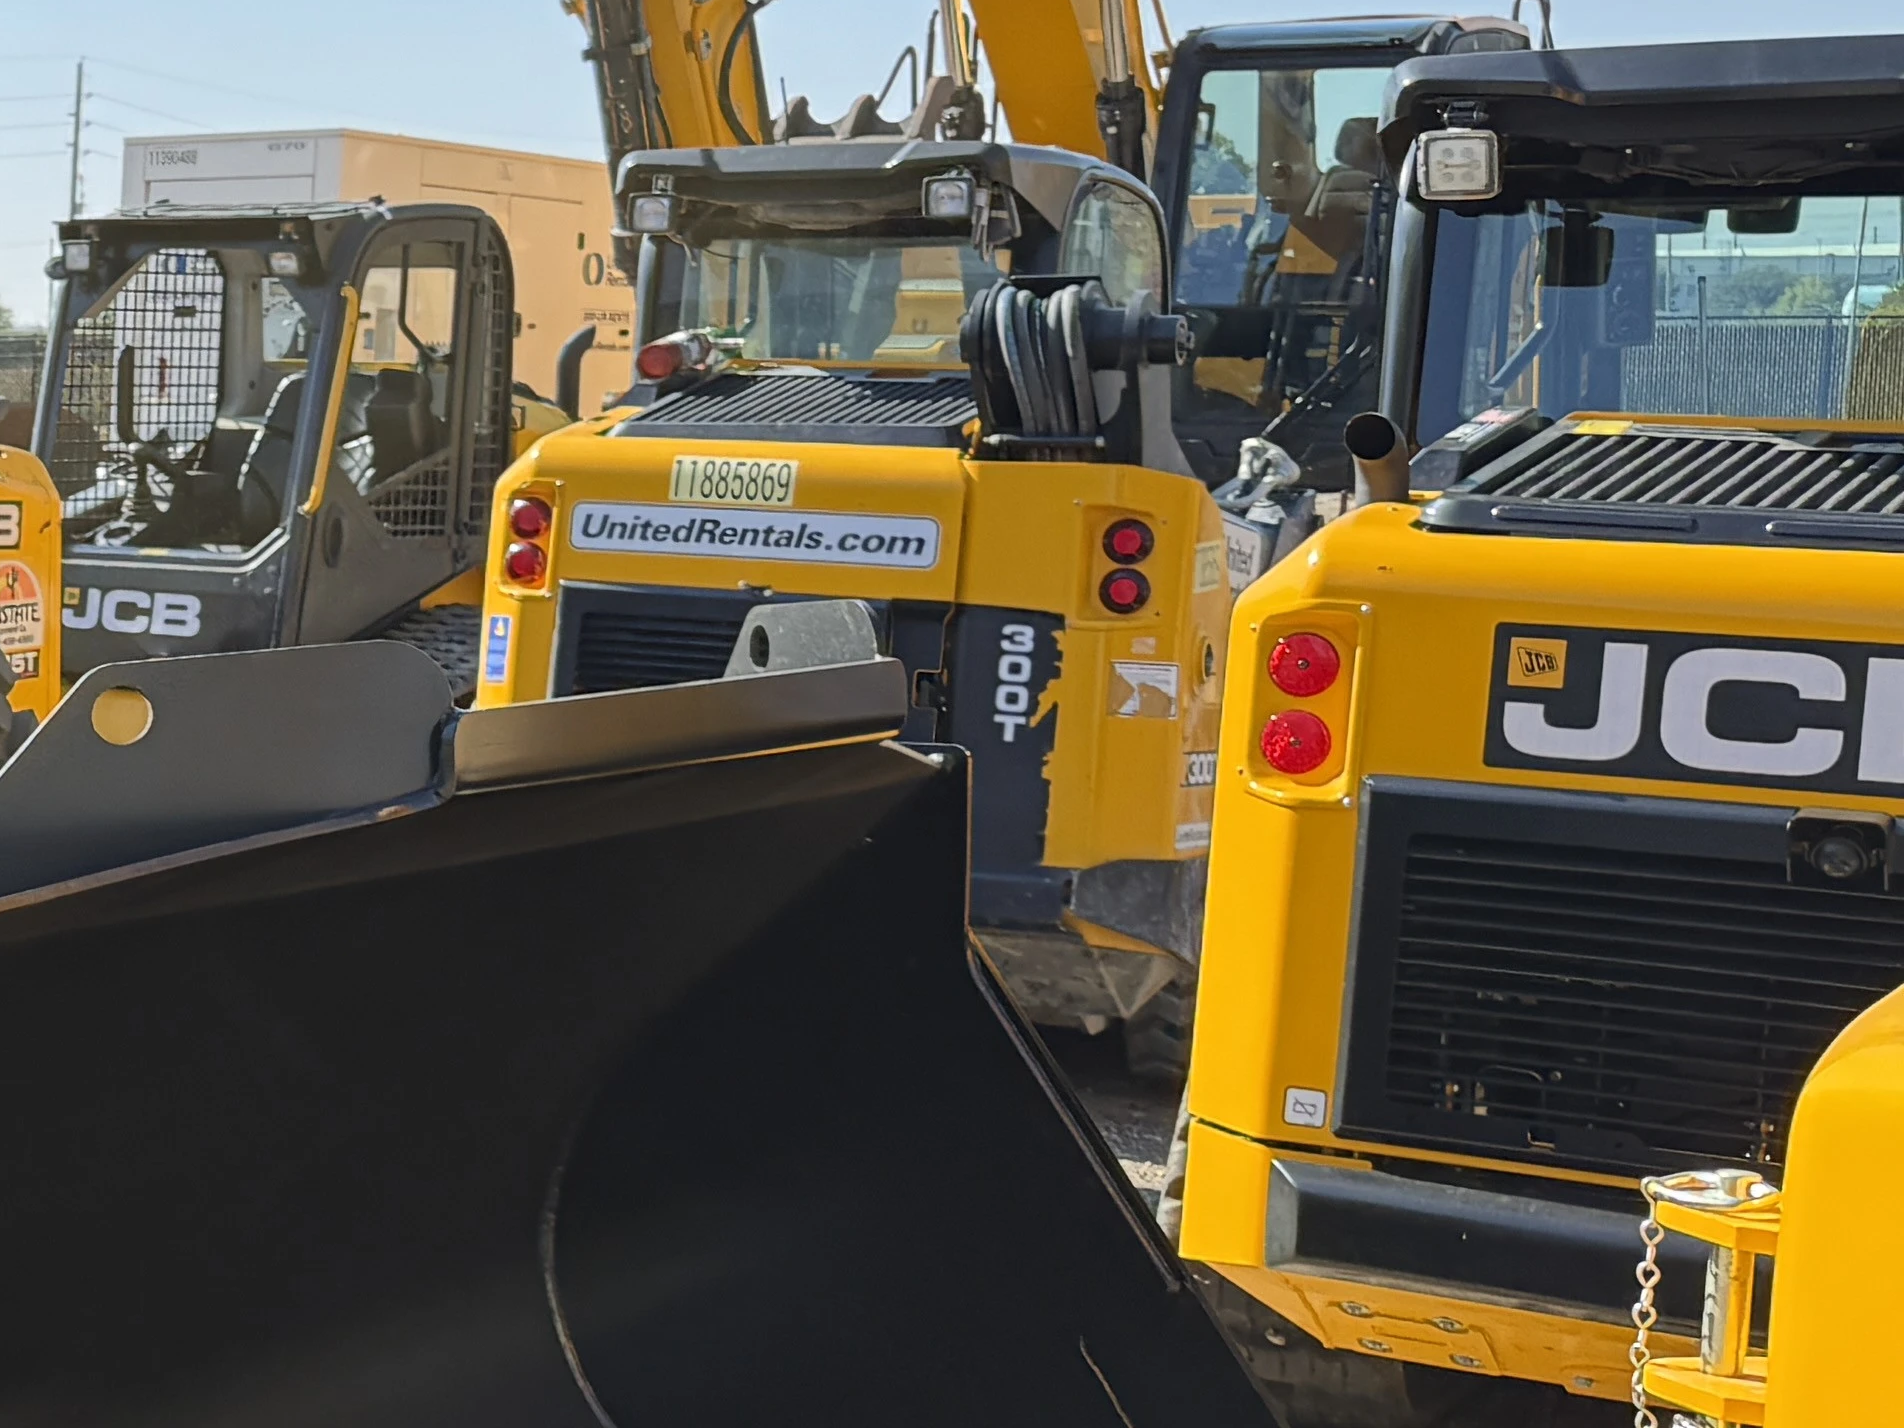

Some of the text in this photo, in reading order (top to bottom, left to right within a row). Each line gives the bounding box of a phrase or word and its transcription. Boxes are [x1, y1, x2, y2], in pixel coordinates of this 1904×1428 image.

[672, 458, 793, 503] 11885869
[580, 513, 927, 557] UnitedRentals.com
[62, 587, 202, 638] JCB
[6, 651, 38, 674] 5T
[993, 623, 1036, 743] 300T
[1524, 649, 1556, 674] JCB
[1502, 641, 1904, 784] JC
[1186, 753, 1216, 785] 300
